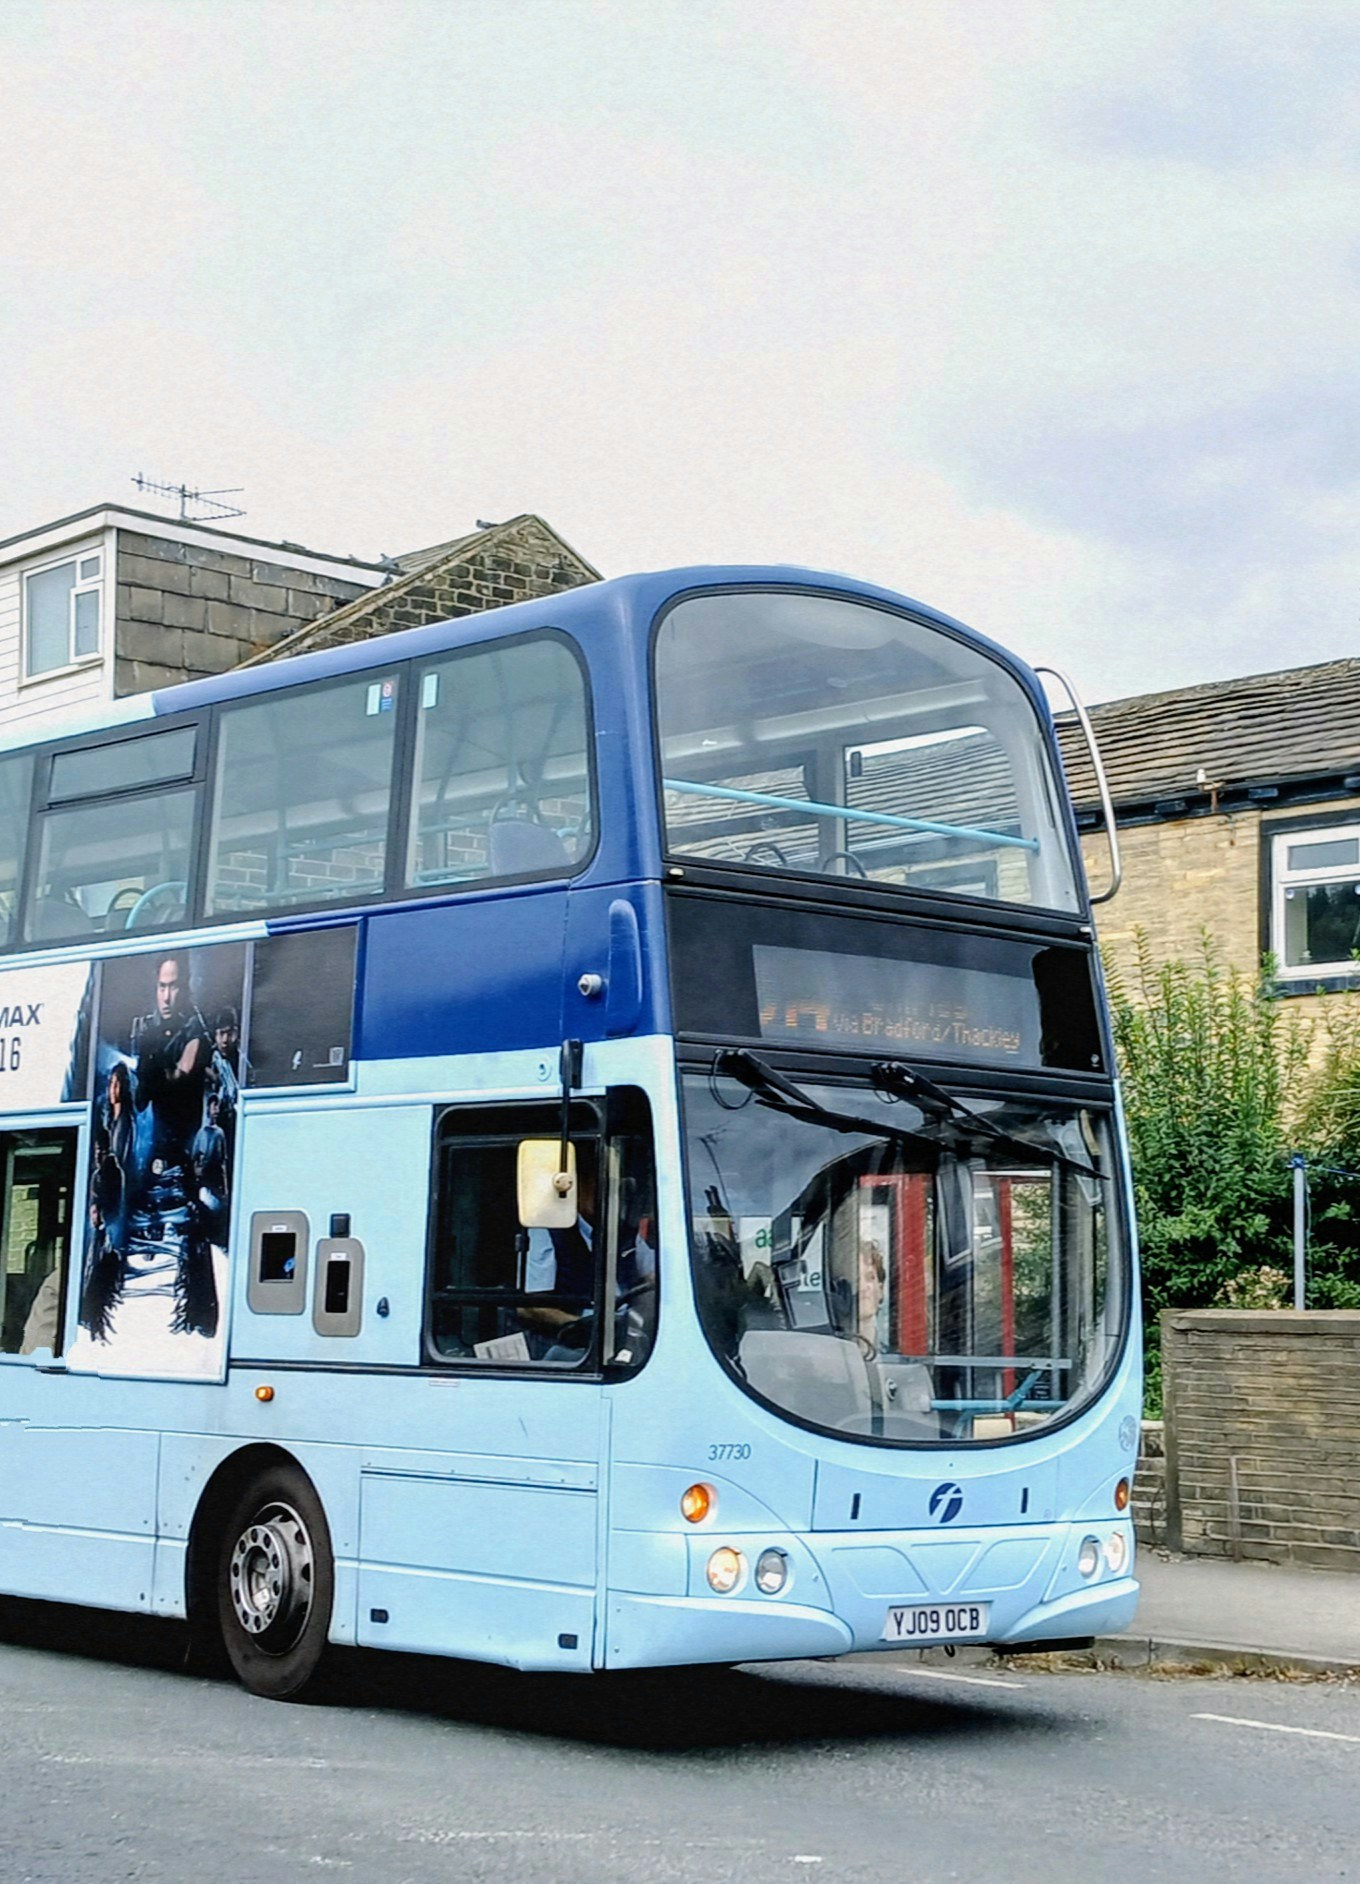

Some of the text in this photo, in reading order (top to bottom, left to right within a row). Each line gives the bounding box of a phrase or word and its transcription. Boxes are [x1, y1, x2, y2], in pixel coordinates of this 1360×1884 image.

[708, 1443, 751, 1461] 37730
[893, 1607, 980, 1636] YJ09 OCB
